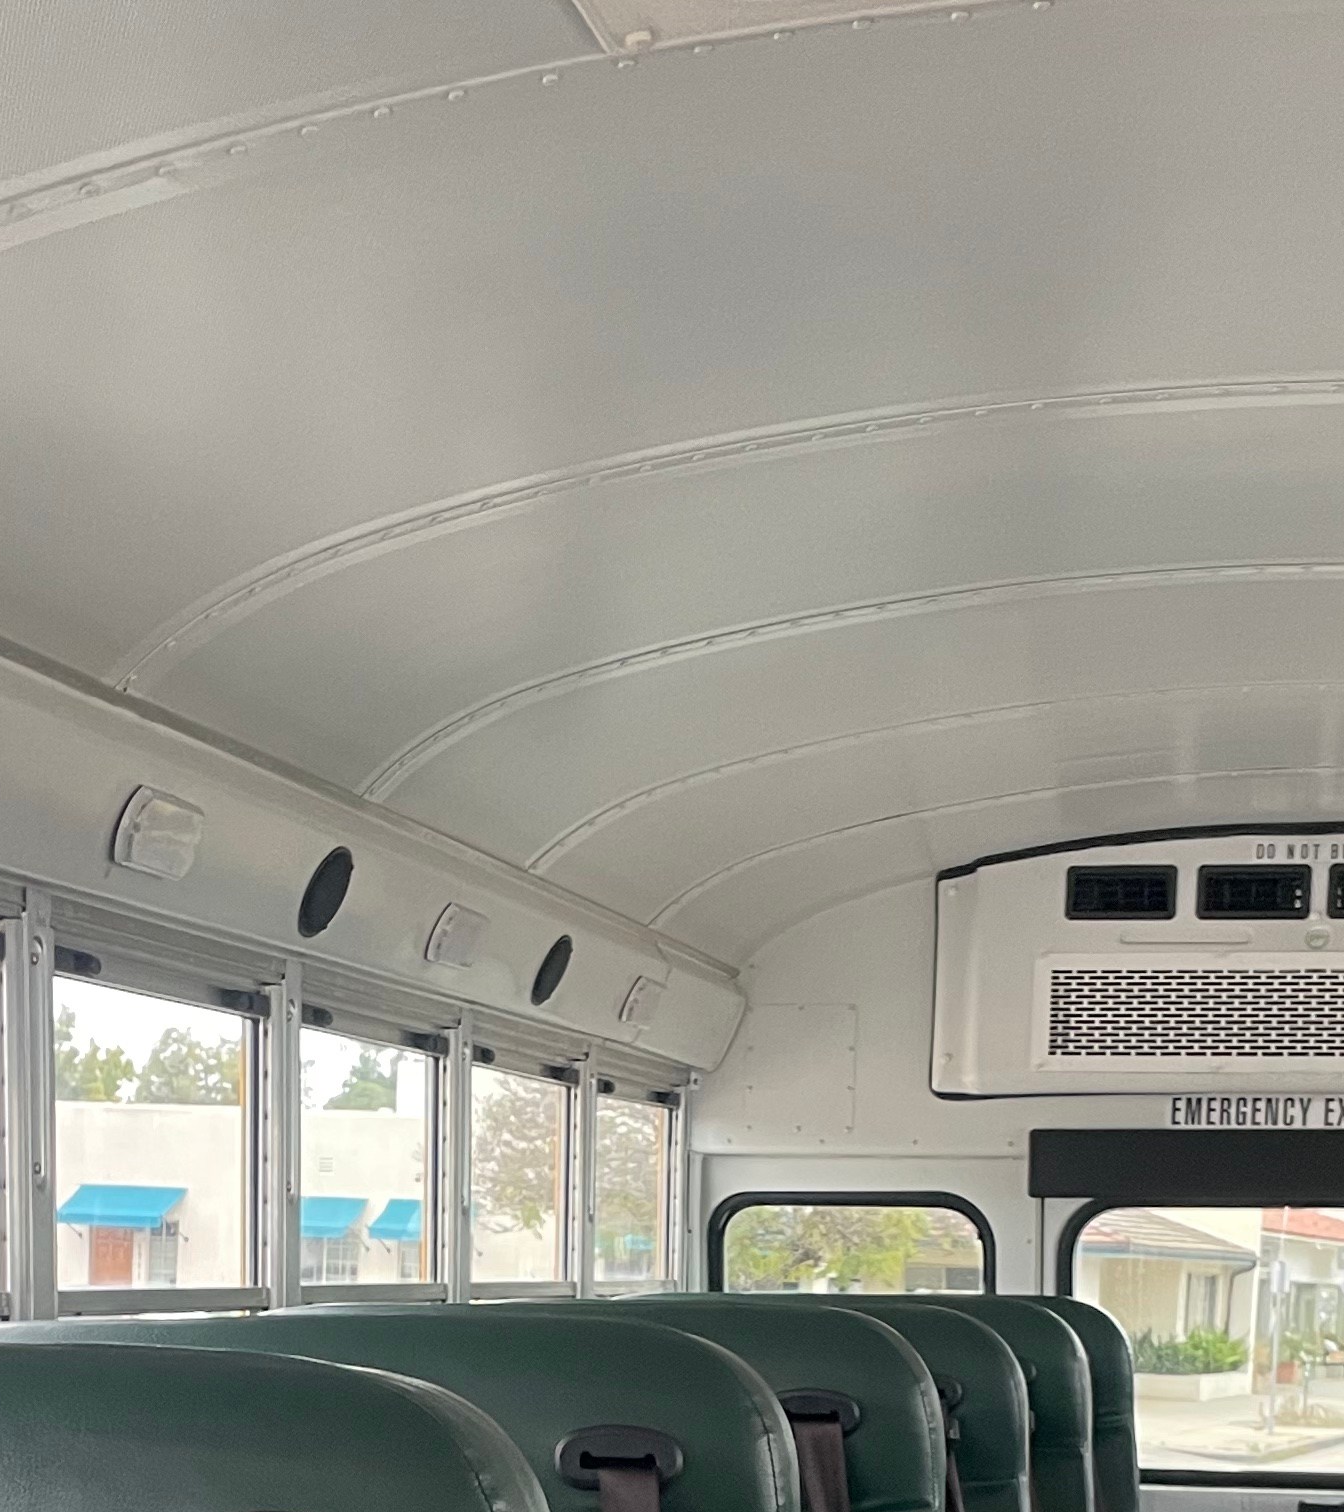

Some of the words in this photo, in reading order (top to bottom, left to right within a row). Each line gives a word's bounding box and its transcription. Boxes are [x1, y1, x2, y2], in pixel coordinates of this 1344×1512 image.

[1256, 843, 1277, 860] DO
[1286, 843, 1321, 860] NOT
[1170, 1097, 1312, 1127] EMERGENCY
